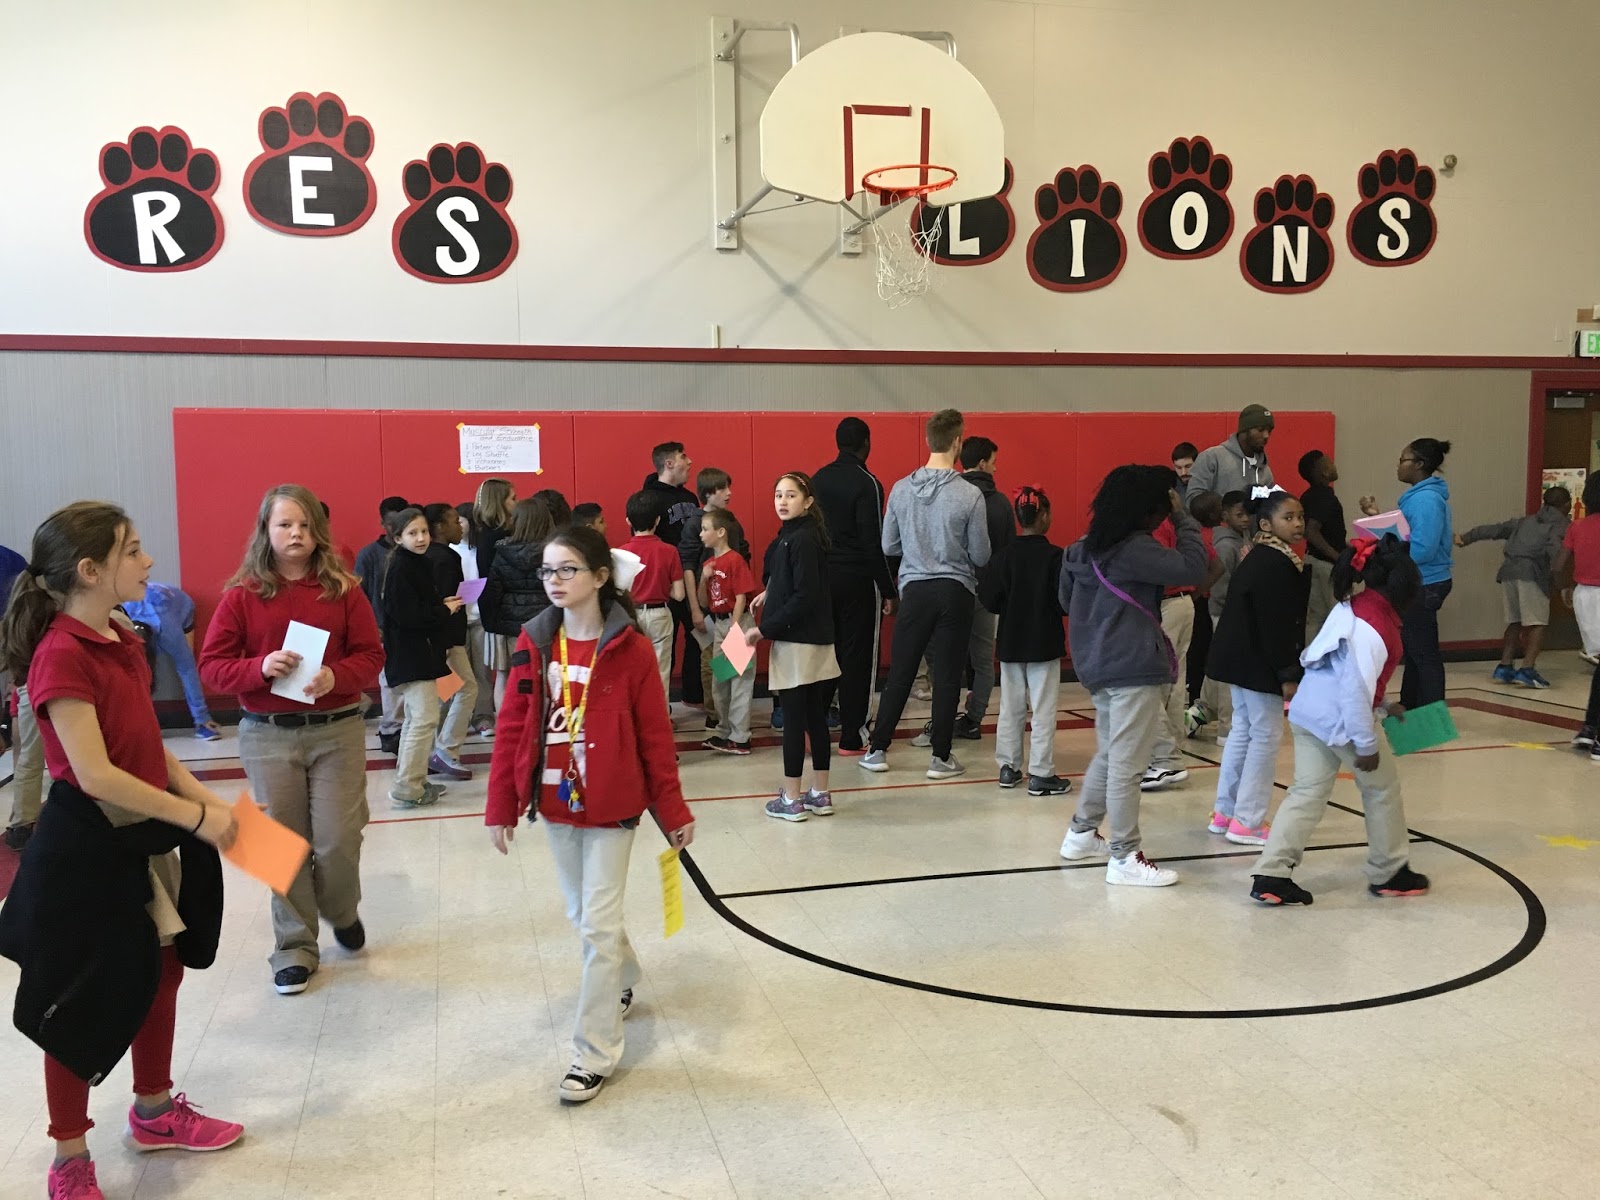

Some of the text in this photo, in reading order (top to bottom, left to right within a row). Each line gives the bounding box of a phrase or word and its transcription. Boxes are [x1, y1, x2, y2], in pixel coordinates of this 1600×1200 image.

[463, 427, 532, 436] Muscular Strength
[496, 434, 534, 442] Endurance
[472, 442, 491, 450] Partner
[472, 451, 482, 459] Leg
[485, 450, 509, 459] Shuffle
